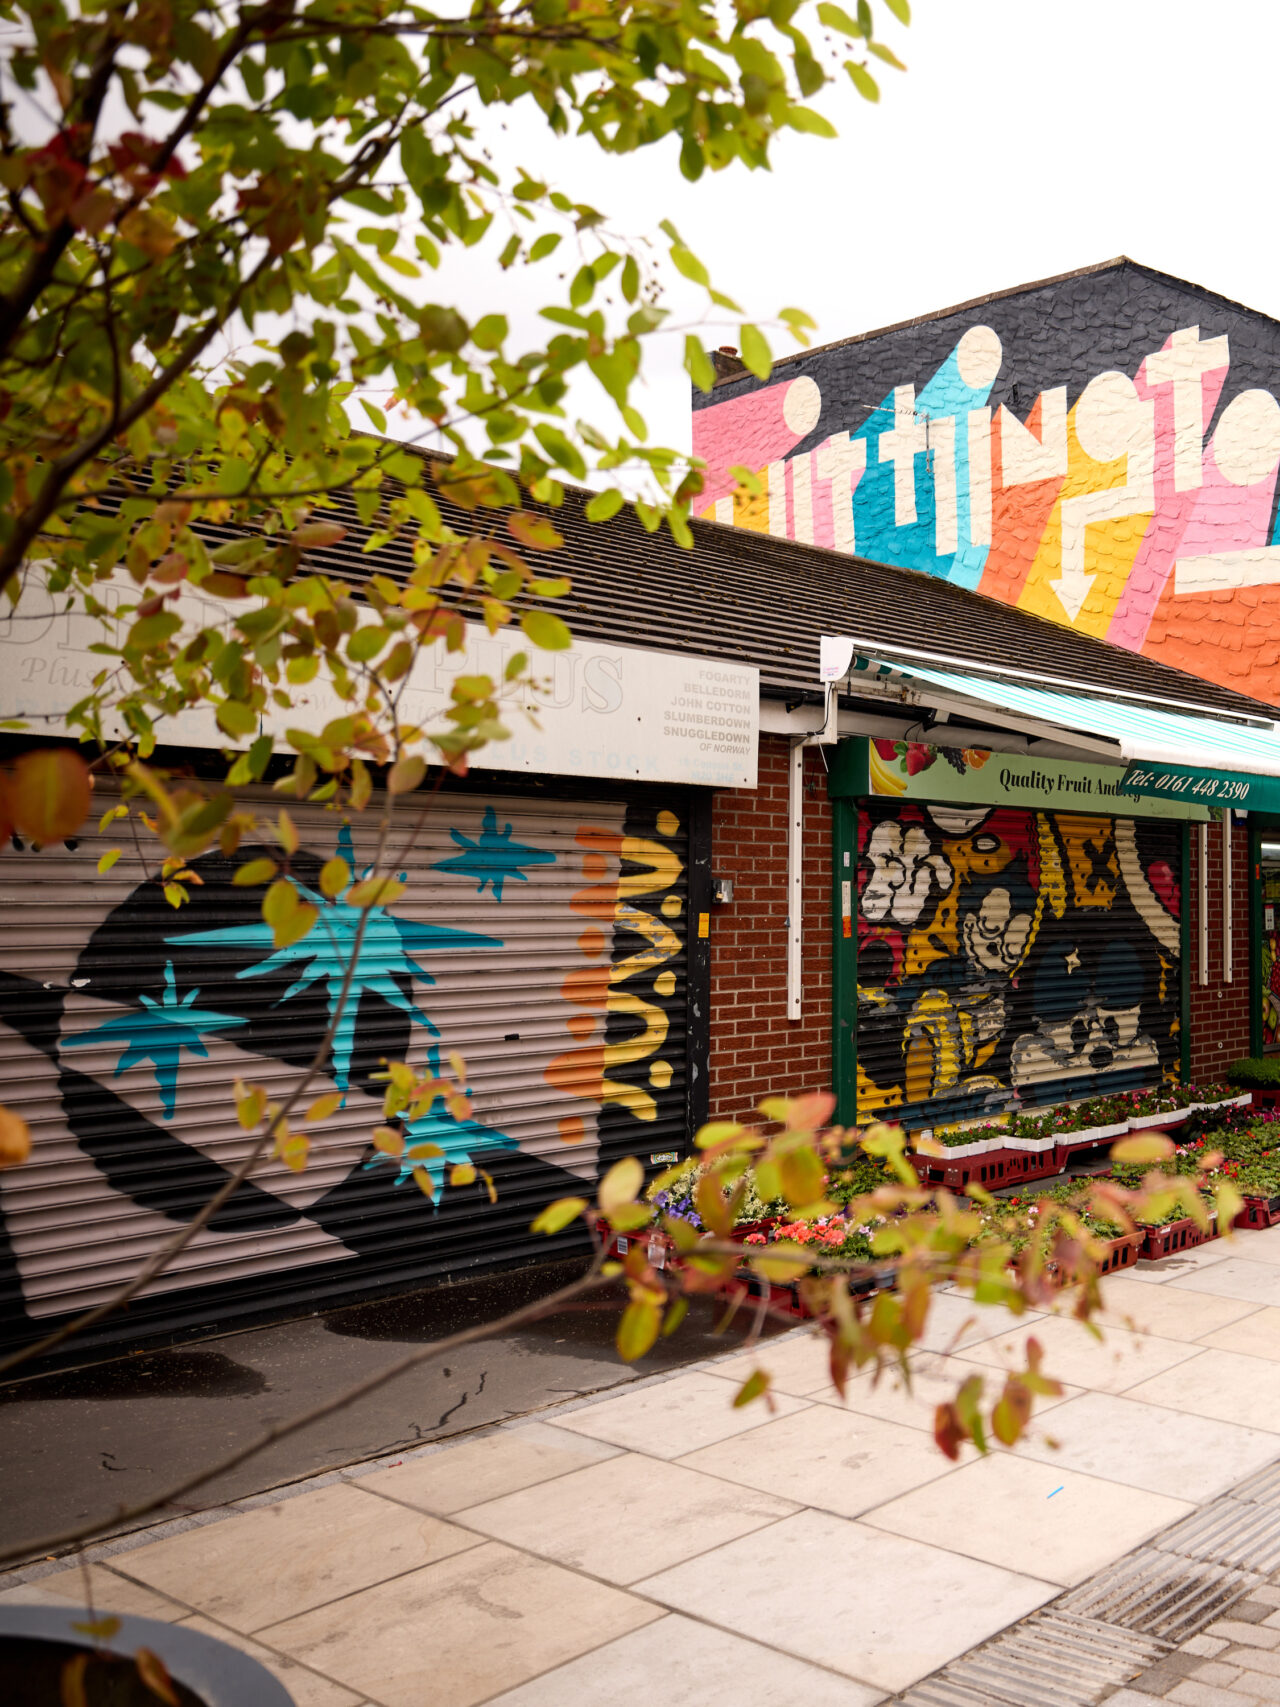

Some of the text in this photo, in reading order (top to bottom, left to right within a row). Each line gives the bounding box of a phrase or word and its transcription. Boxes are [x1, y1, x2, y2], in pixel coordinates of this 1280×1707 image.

[698, 670, 751, 686] FOGARTY
[683, 683, 751, 700] BELLEDORM
[671, 696, 751, 715] JOHN COTTON
[663, 711, 751, 730] SLUMBERDOWN
[663, 726, 751, 744] SNUGGLEDOWN
[699, 742, 751, 755] OF NORWAY
[999, 768, 1055, 795] Quality
[1057, 774, 1092, 795] Fruit
[1125, 769, 1250, 800] Tel: 0161 448 2390
